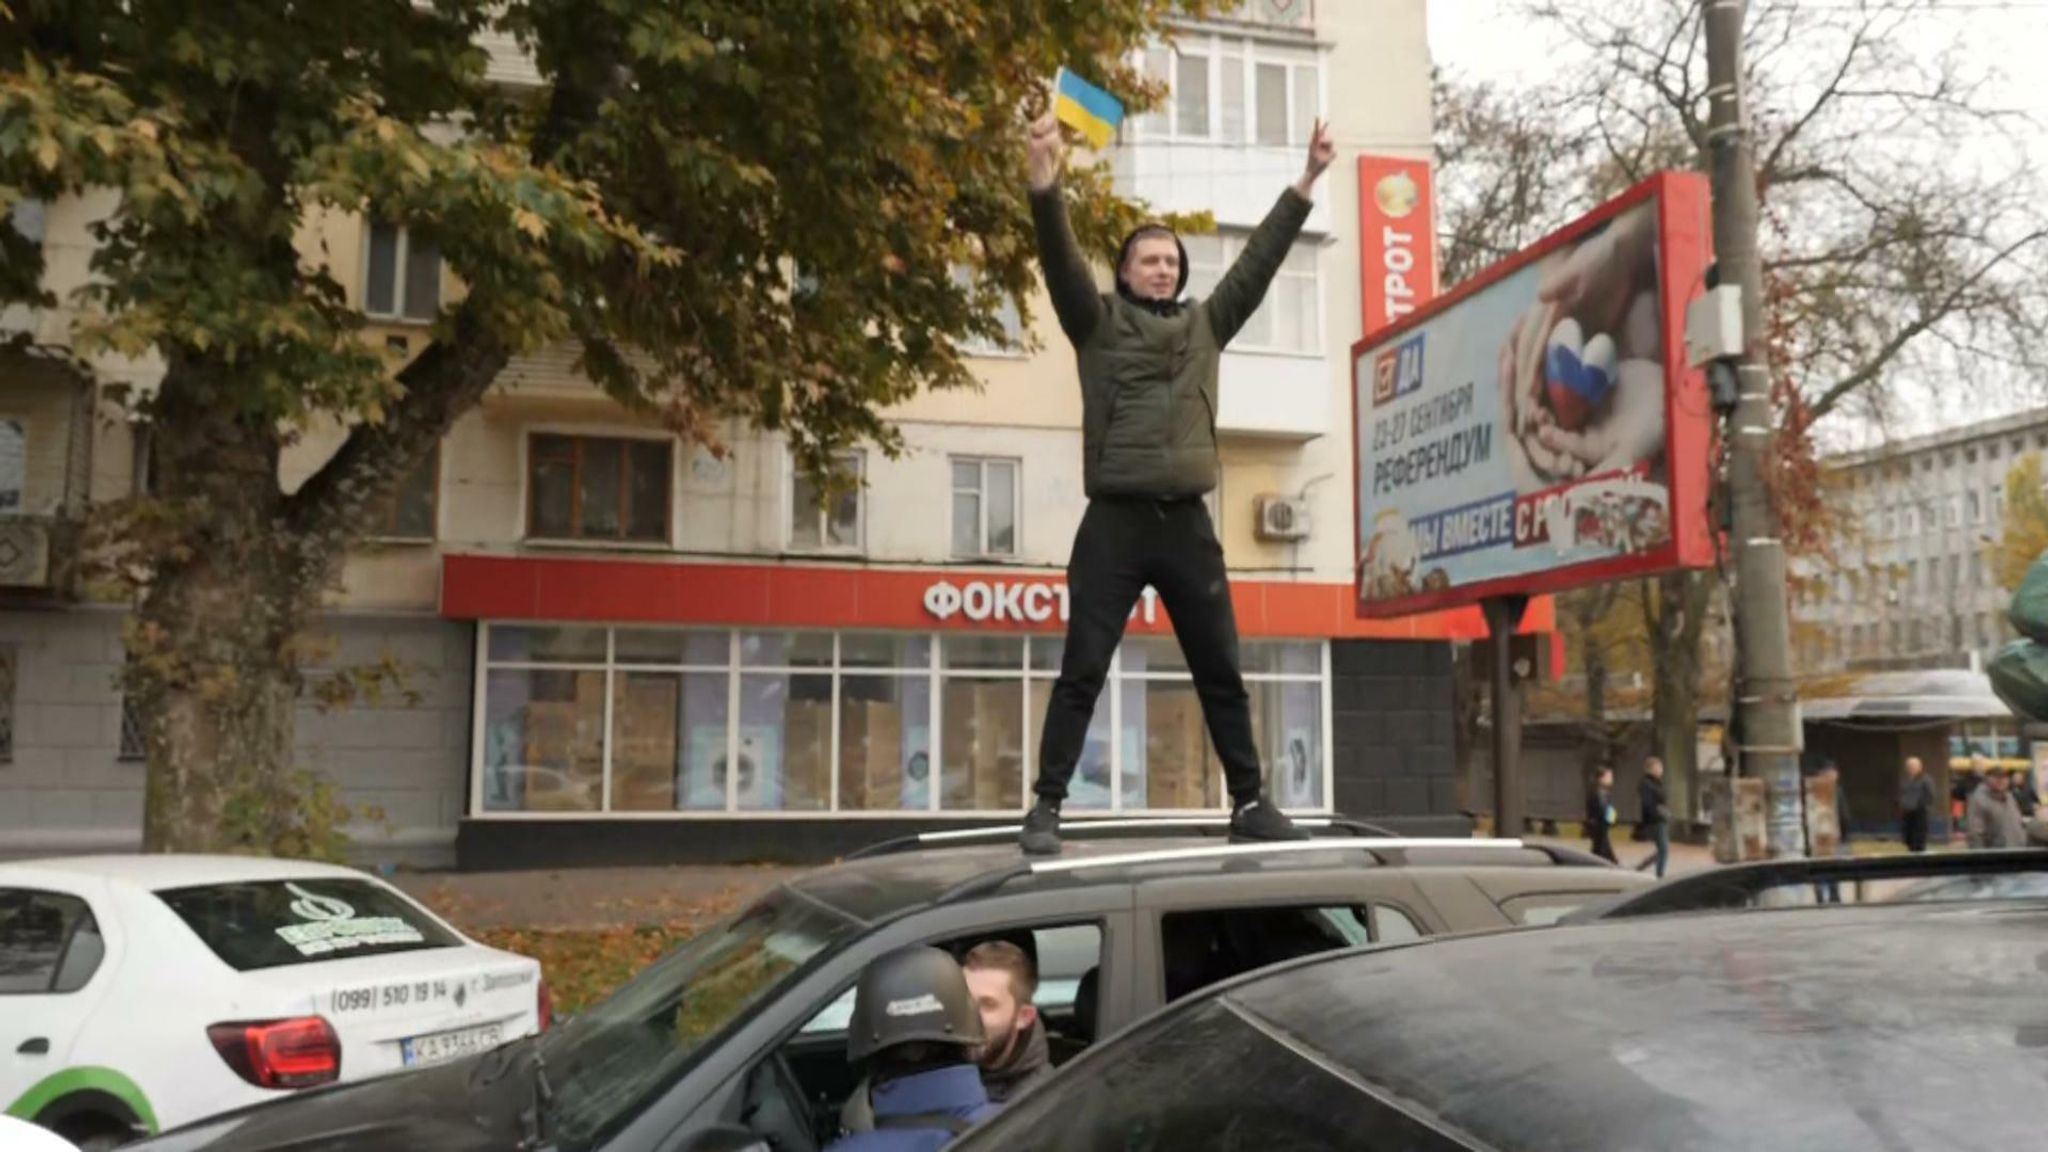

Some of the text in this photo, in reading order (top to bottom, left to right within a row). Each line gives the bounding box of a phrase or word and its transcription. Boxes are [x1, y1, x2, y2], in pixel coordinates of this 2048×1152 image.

[1410, 381, 1475, 438] СЕНТЯБРЯ
[1373, 422, 1492, 495] РЕФЕРЕНДУМ
[1441, 499, 1513, 552] ВМЕСТЕ
[331, 985, 378, 1016] (099)
[382, 983, 409, 1008] 510
[414, 981, 429, 1002] 19
